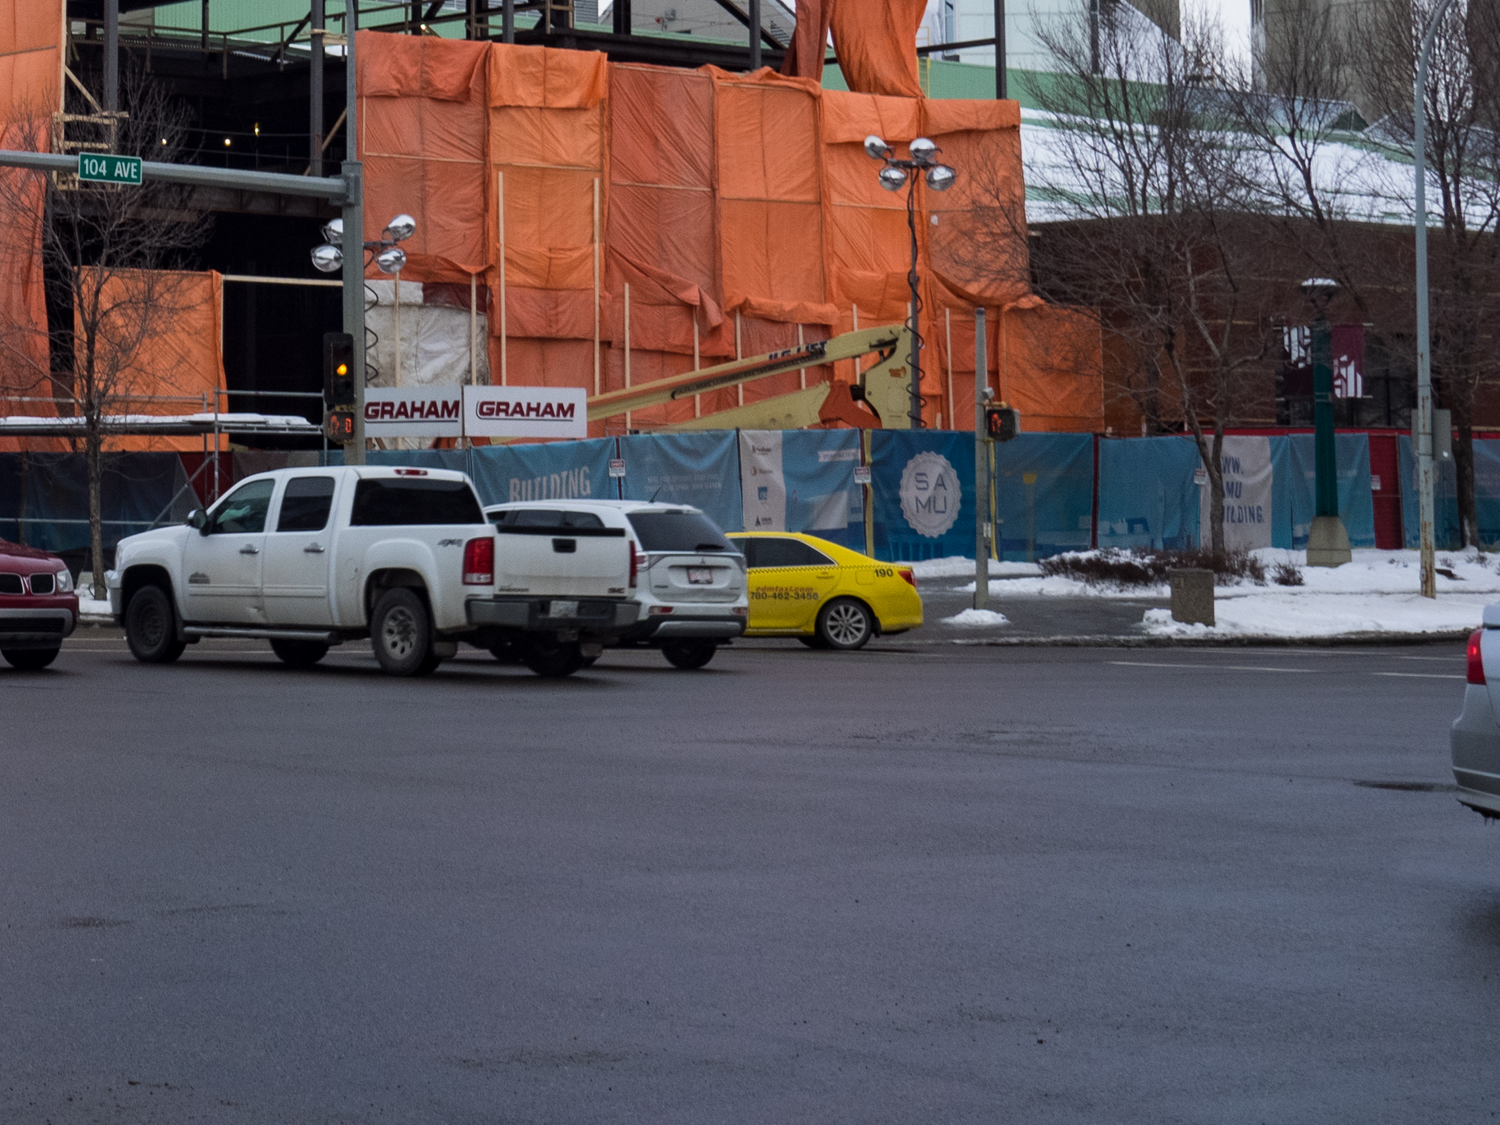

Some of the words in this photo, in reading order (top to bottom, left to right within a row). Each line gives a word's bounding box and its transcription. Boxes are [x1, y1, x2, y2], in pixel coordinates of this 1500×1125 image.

[83, 158, 107, 176] 104
[114, 161, 138, 179] AVE
[364, 400, 461, 420] GRAHAM
[477, 400, 575, 418] GRAHAM
[1221, 456, 1244, 475] WW.
[509, 465, 592, 503] BUILDING
[874, 569, 893, 578] 190
[750, 591, 819, 601] 780-462-3456
[755, 585, 814, 593] edmtaxi.com
